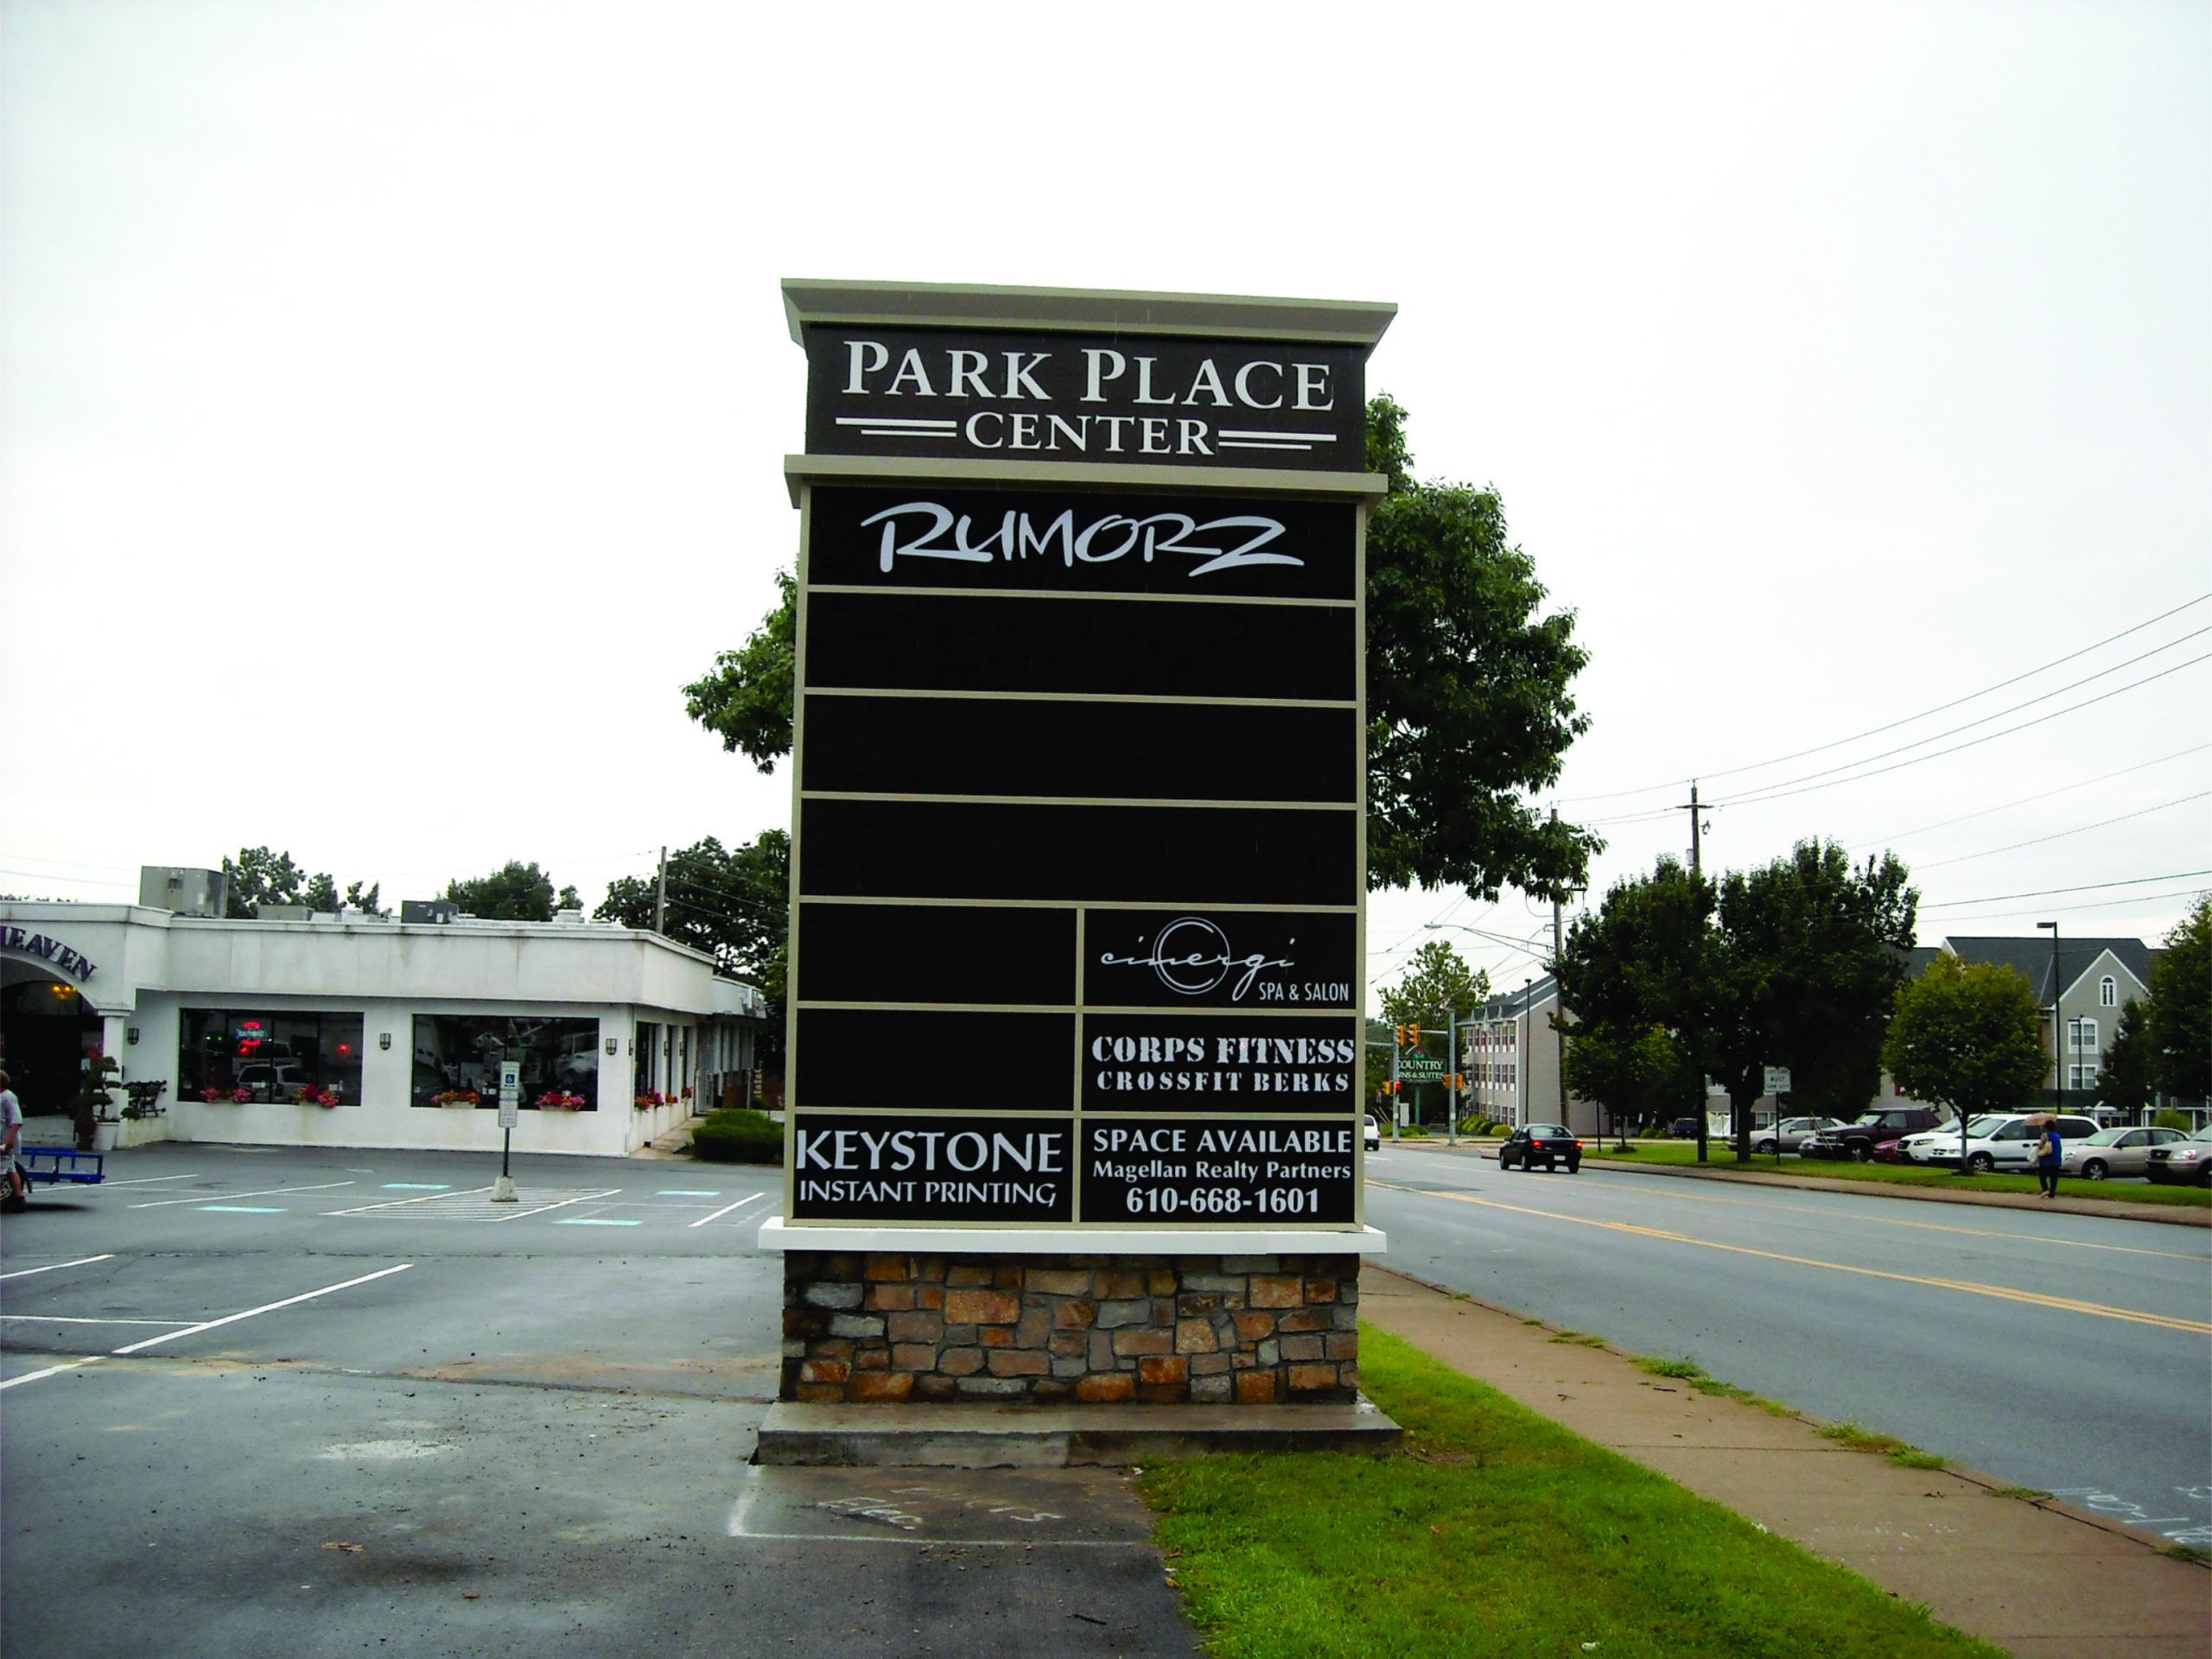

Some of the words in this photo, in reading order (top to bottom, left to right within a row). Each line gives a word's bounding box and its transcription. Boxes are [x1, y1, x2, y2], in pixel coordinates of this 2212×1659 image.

[842, 340, 1052, 400] PARK
[1079, 348, 1335, 412] PLACE
[965, 411, 1215, 455] CENTER
[861, 502, 1305, 577] RUMORZ
[1259, 982, 1284, 1001] SPA
[1288, 983, 1300, 1001] &
[1304, 982, 1349, 1001] SALON
[1092, 1036, 1205, 1064] CORPS
[1217, 1037, 1355, 1065] FITNESS
[1096, 1071, 1243, 1091] CROSSFIT
[1254, 1072, 1349, 1092] BERKS
[796, 1130, 1063, 1173] KEYSTONE
[1094, 1128, 1185, 1154] SPACE
[1197, 1129, 1351, 1154] AVAILABLE
[1093, 1160, 1186, 1183] Magellan
[1196, 1160, 1259, 1184] Realty
[1267, 1161, 1351, 1179] Partners
[800, 1180, 917, 1202] INSTANT
[925, 1181, 1056, 1207] PRINTING
[1126, 1187, 1319, 1213] 610-668-1601
